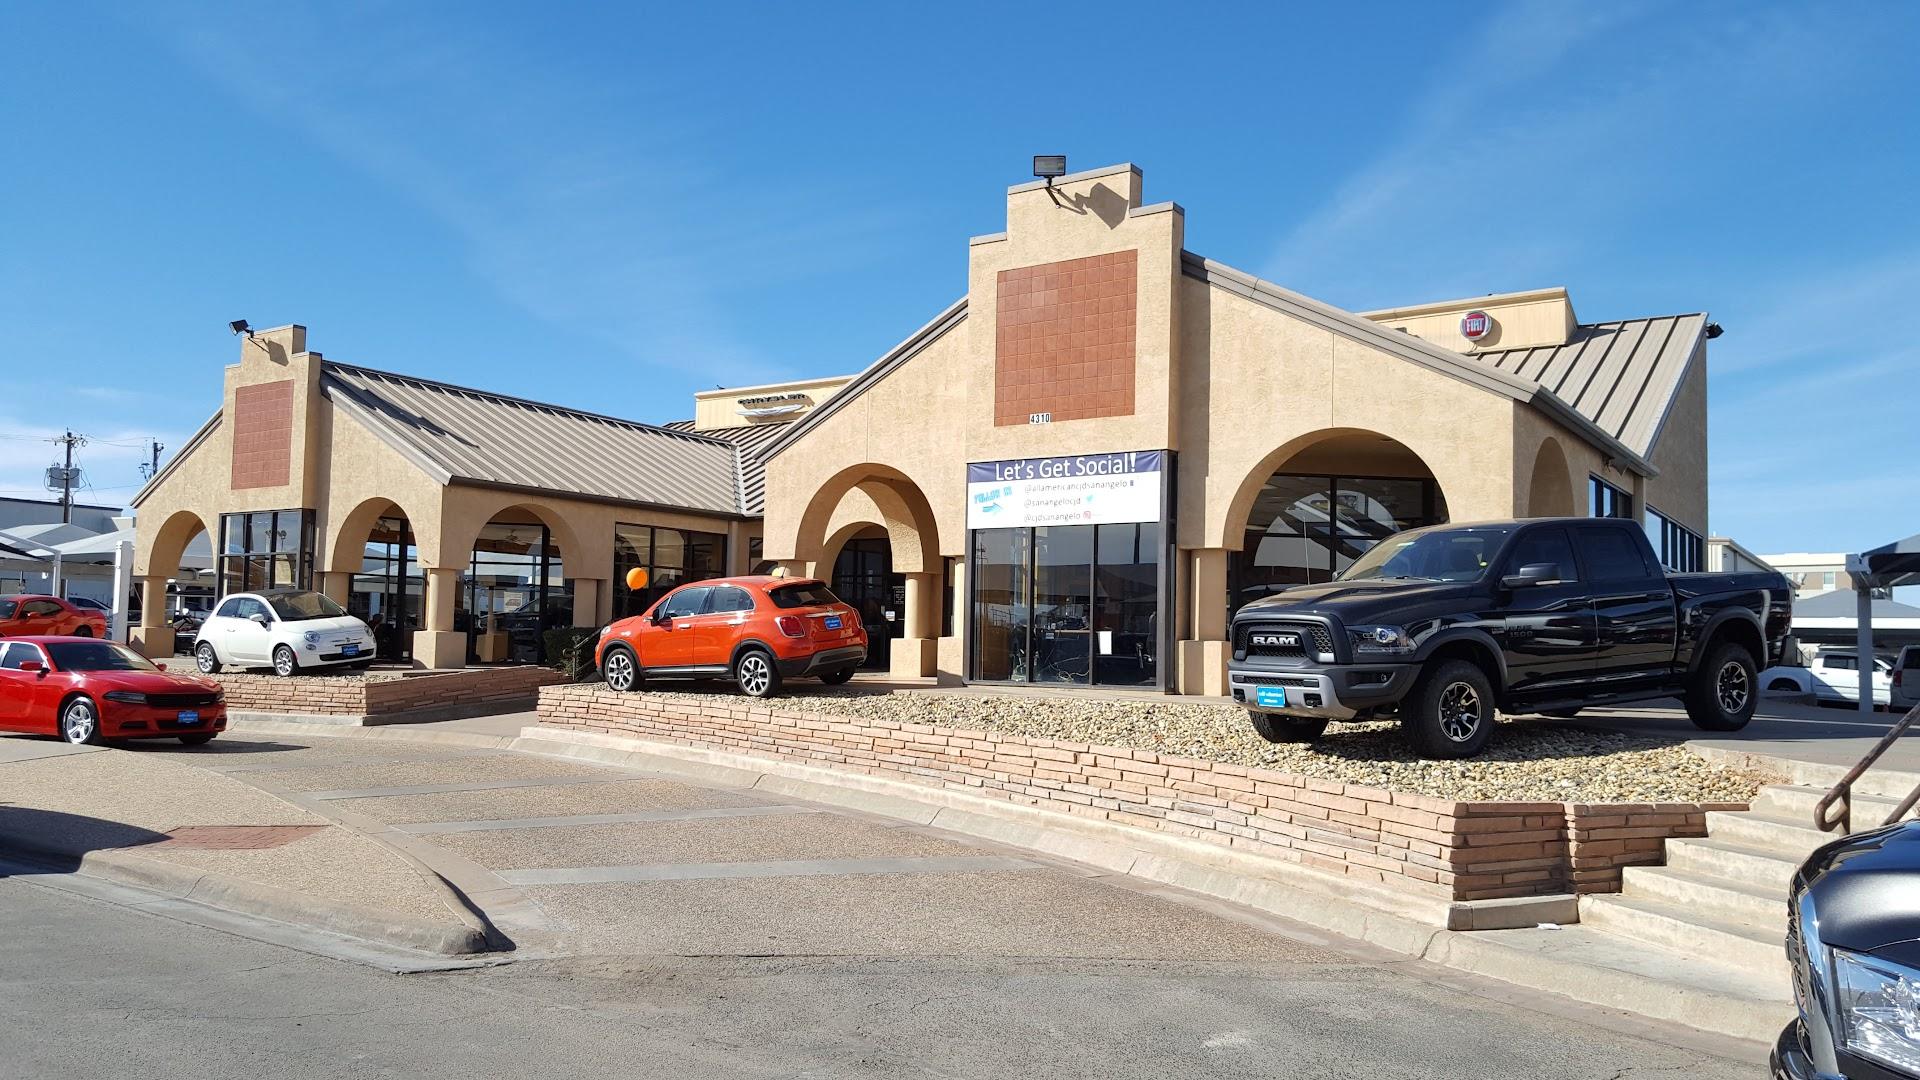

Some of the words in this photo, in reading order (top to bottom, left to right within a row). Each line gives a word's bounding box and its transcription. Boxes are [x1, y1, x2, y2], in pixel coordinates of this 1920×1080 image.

[1030, 413, 1049, 423] 4310
[1039, 459, 1071, 477] Get
[1075, 453, 1137, 475] Social!
[1252, 636, 1296, 645] RAM
